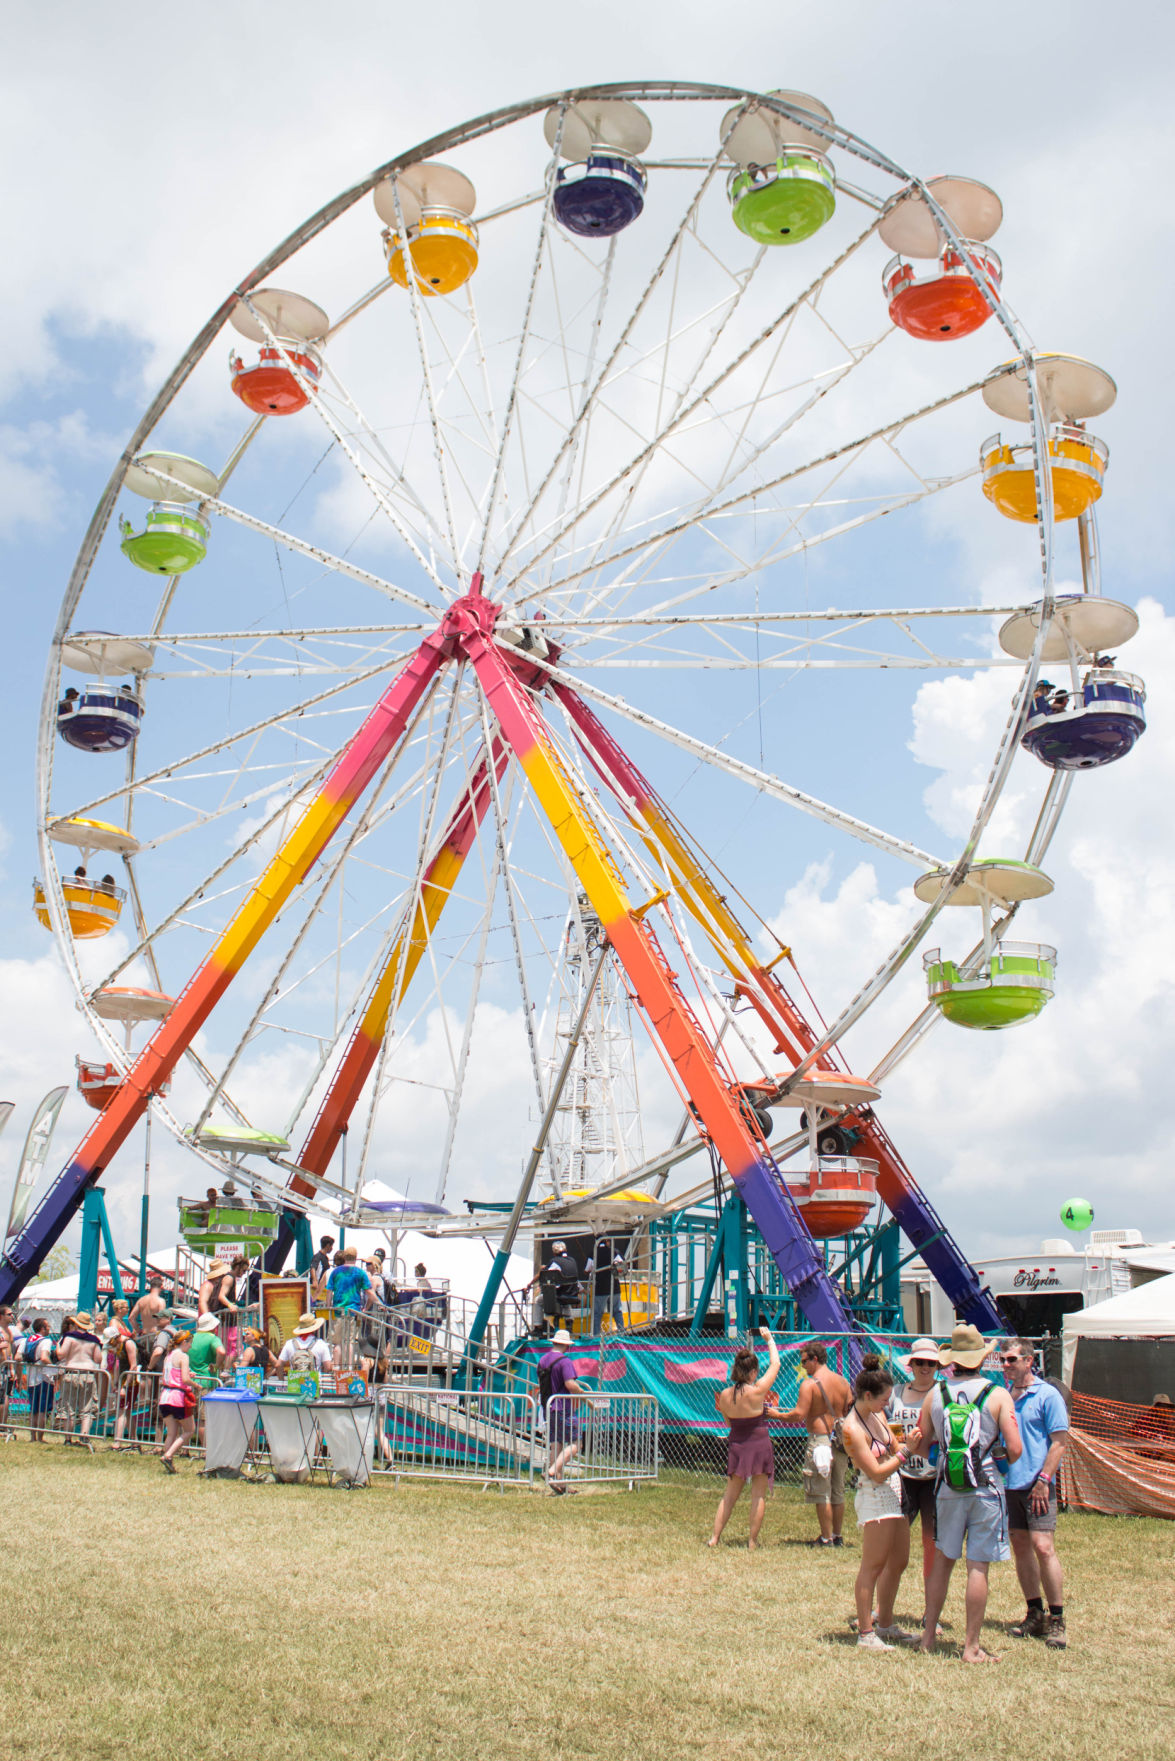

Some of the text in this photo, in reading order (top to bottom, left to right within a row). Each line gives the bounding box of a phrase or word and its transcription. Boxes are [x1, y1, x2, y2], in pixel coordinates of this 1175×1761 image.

[20, 1111, 53, 1186] ATM
[1065, 1207, 1074, 1221] 4
[98, 1275, 134, 1292] ENTING
[1014, 1272, 1059, 1291] Pilgrim
[410, 1338, 429, 1352] EXIT
[895, 1409, 921, 1419] HER
[903, 1457, 924, 1468] UN
